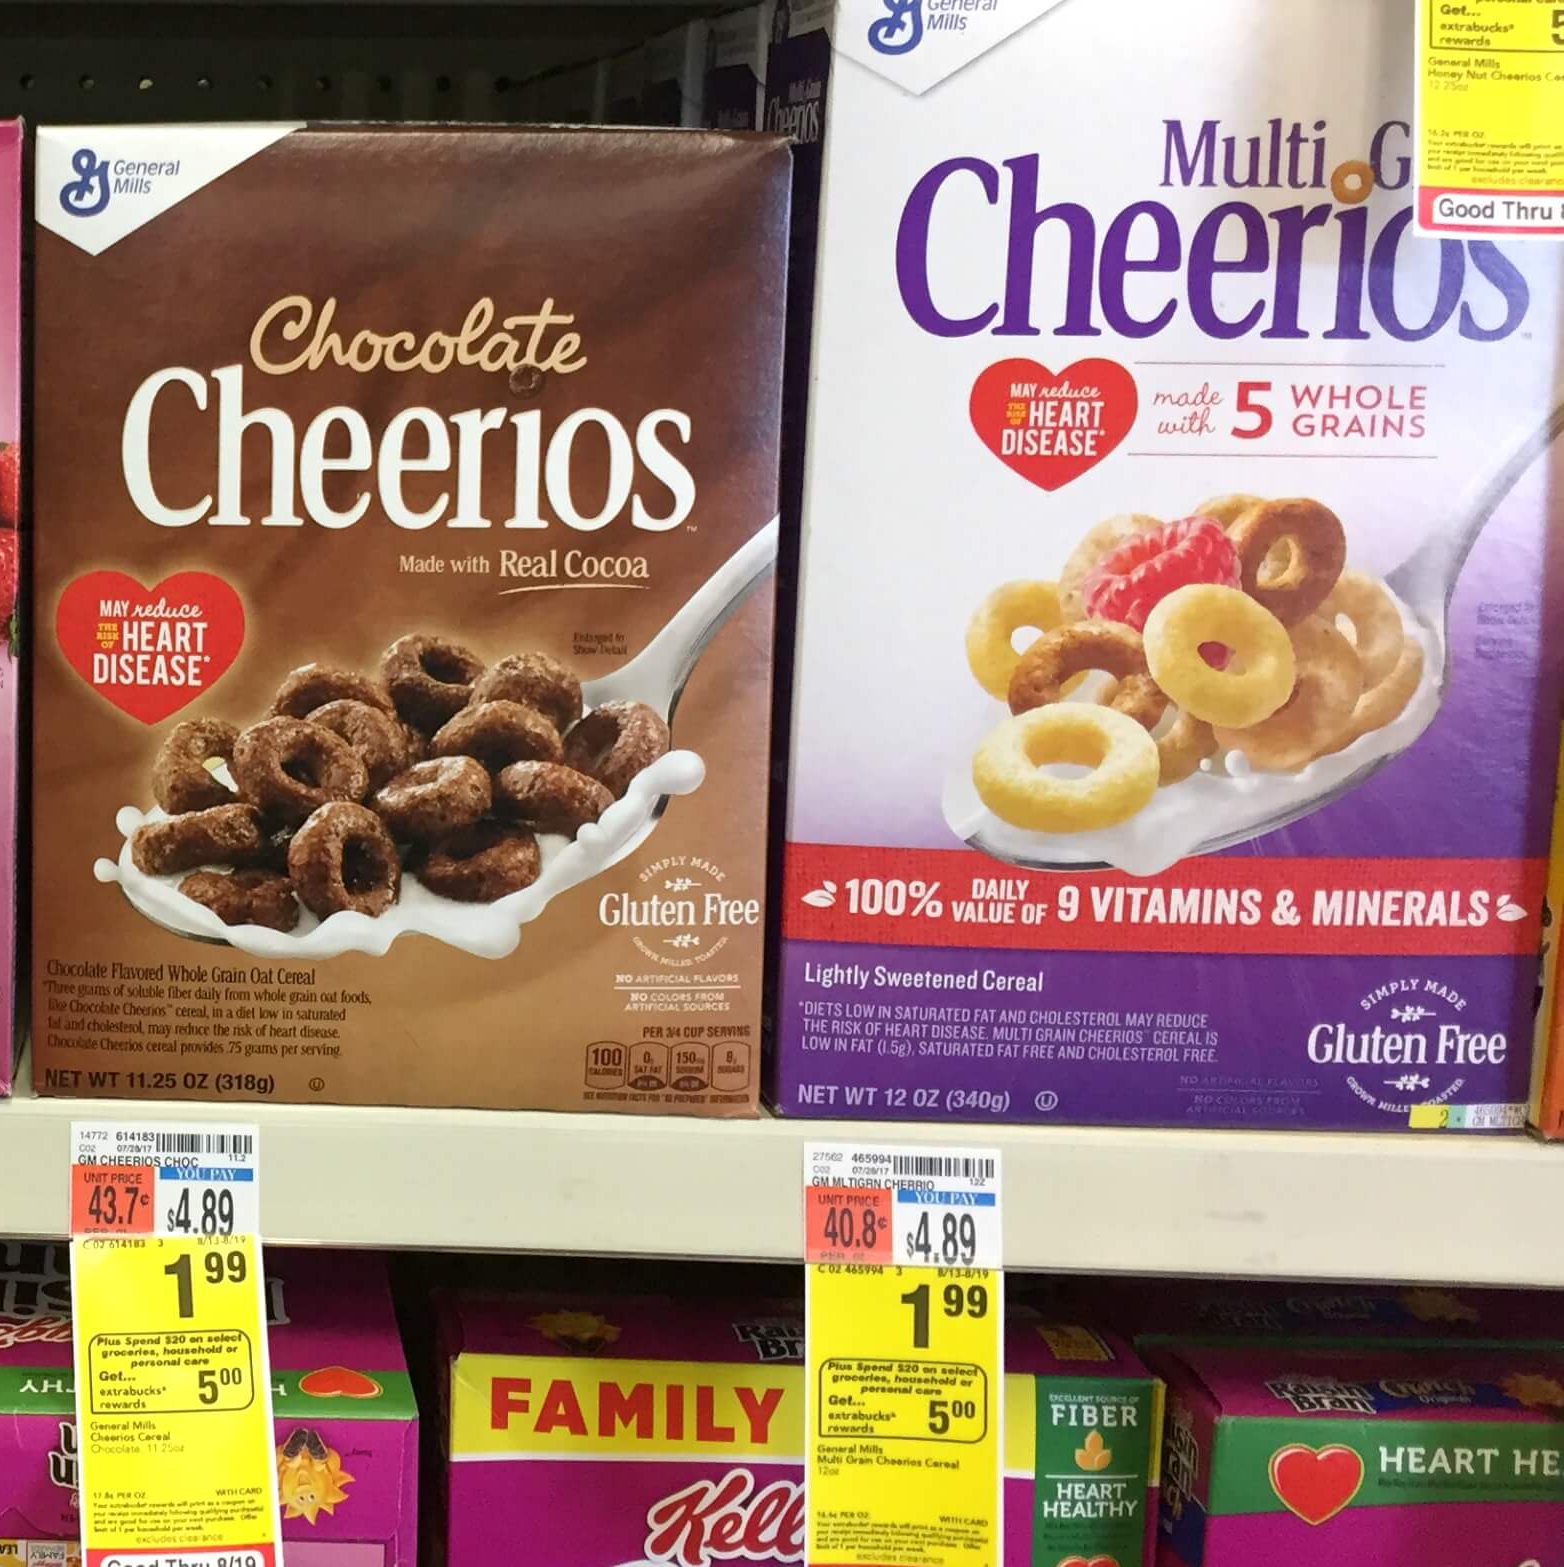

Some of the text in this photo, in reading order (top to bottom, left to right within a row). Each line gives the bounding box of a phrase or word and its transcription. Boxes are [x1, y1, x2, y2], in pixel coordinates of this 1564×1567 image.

[927, 14, 967, 30] Mills
[1159, 118, 1326, 189] Multi
[113, 158, 180, 179] General
[113, 176, 152, 196] Mills
[1439, 198, 1552, 220] Good Thru
[895, 153, 1531, 342] Cheerios
[249, 295, 587, 376] Chocolate
[1010, 384, 1100, 400] MAY reduce
[1154, 382, 1224, 408] made
[1290, 385, 1427, 410] WHOLE
[1028, 401, 1105, 427] HEART
[1158, 412, 1216, 435] with
[1231, 381, 1273, 440] 5
[1291, 414, 1427, 438] GRAINS
[122, 364, 696, 532] Cheerios
[399, 550, 650, 580] Made with Real Cocoa
[100, 597, 203, 618] MAY reduce
[122, 621, 208, 652] HEART
[845, 880, 943, 918] 100%
[972, 879, 1028, 901] DAILY
[599, 892, 759, 926] Gluten Free
[952, 901, 1048, 926] VALUE OF
[1057, 887, 1489, 928] 9 VITAMINS & MINERALS
[47, 960, 315, 985] Chocolate Flavored Whole Grain Oat Cereal
[804, 963, 1044, 991] Lightly Sweetened Cereal
[1308, 1026, 1507, 1067] Gluten Free
[45, 1068, 275, 1094] NET WT 11.25 OZ (318g)
[798, 1085, 1010, 1112] NET WT 12 OZ (340g)
[78, 1156, 198, 1168] GM CHEERIOS CHOC
[168, 1187, 234, 1236] $4.89
[907, 1211, 976, 1265] $4.89
[490, 1377, 785, 1445] FAMILY
[1051, 1404, 1138, 1427] FIBER
[1379, 1447, 1498, 1474] HEART
[1057, 1483, 1126, 1501] HEART
[1043, 1501, 1138, 1519] HEALTHY
